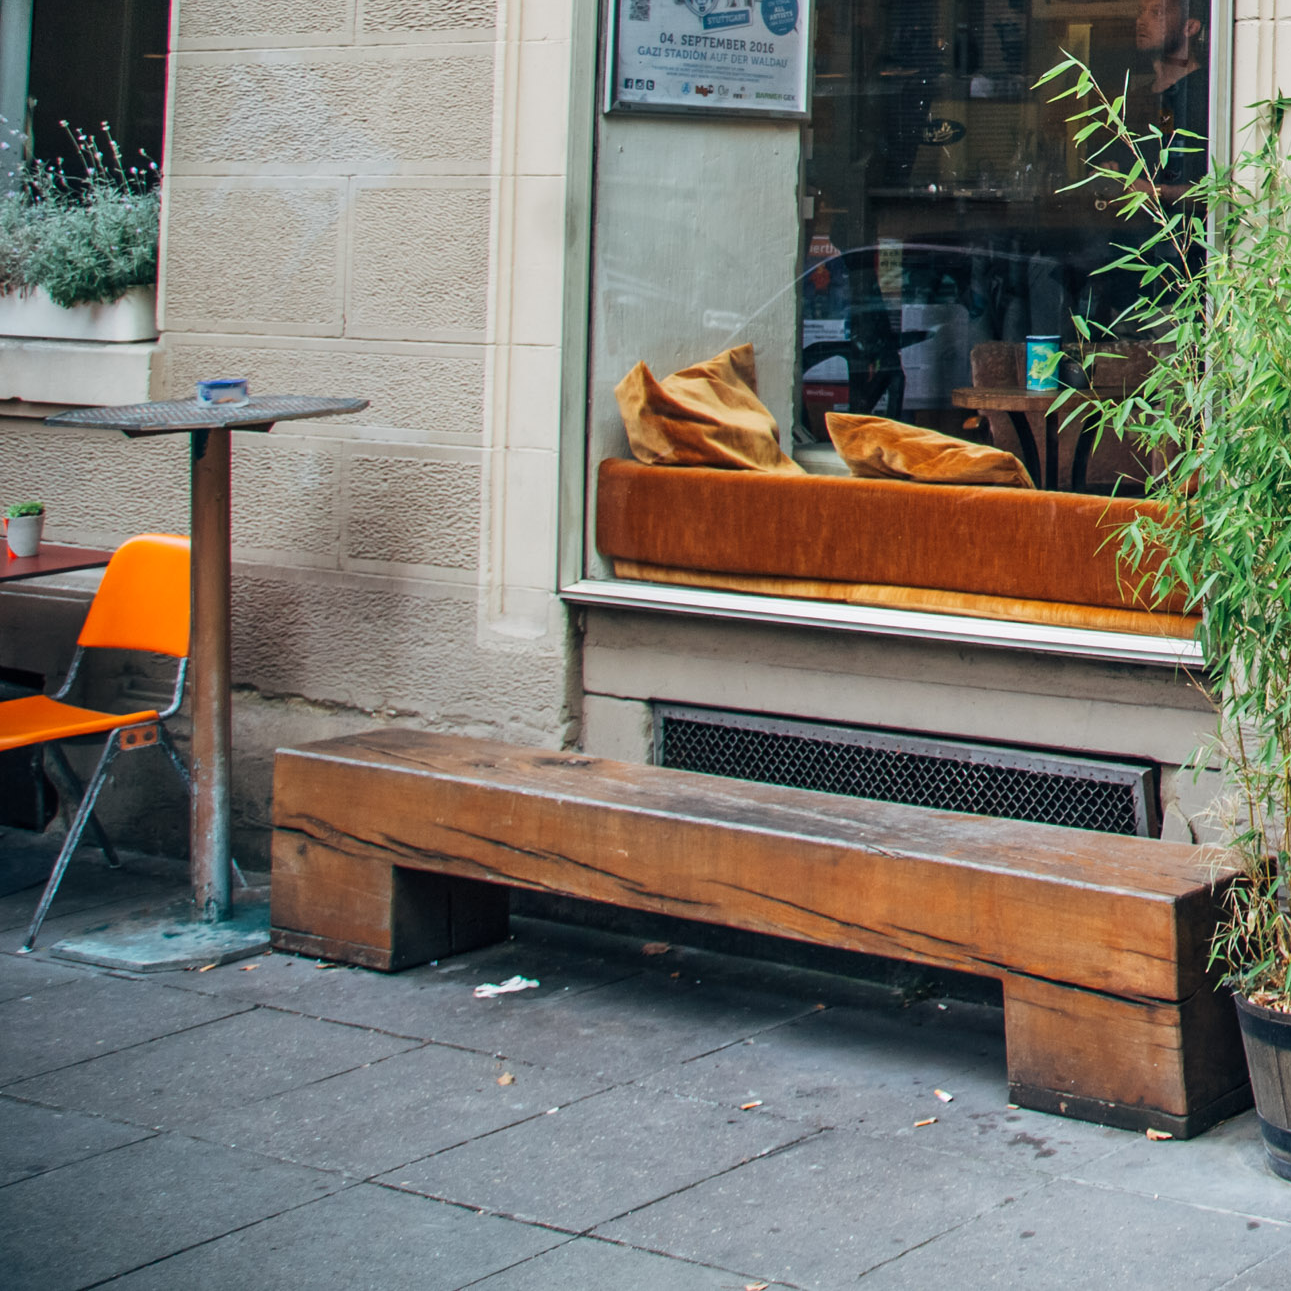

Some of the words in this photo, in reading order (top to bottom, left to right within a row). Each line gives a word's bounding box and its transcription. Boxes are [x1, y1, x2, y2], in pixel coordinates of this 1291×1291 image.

[706, 13, 748, 26] STUTTGART
[659, 32, 677, 45] 04.
[681, 35, 747, 52] SEPTEMBER
[750, 40, 775, 54] 2016
[637, 45, 662, 57] GAZI
[664, 48, 708, 61] STADION
[710, 52, 729, 63] AUF
[730, 54, 749, 65] DER
[751, 55, 788, 69] WALDAU
